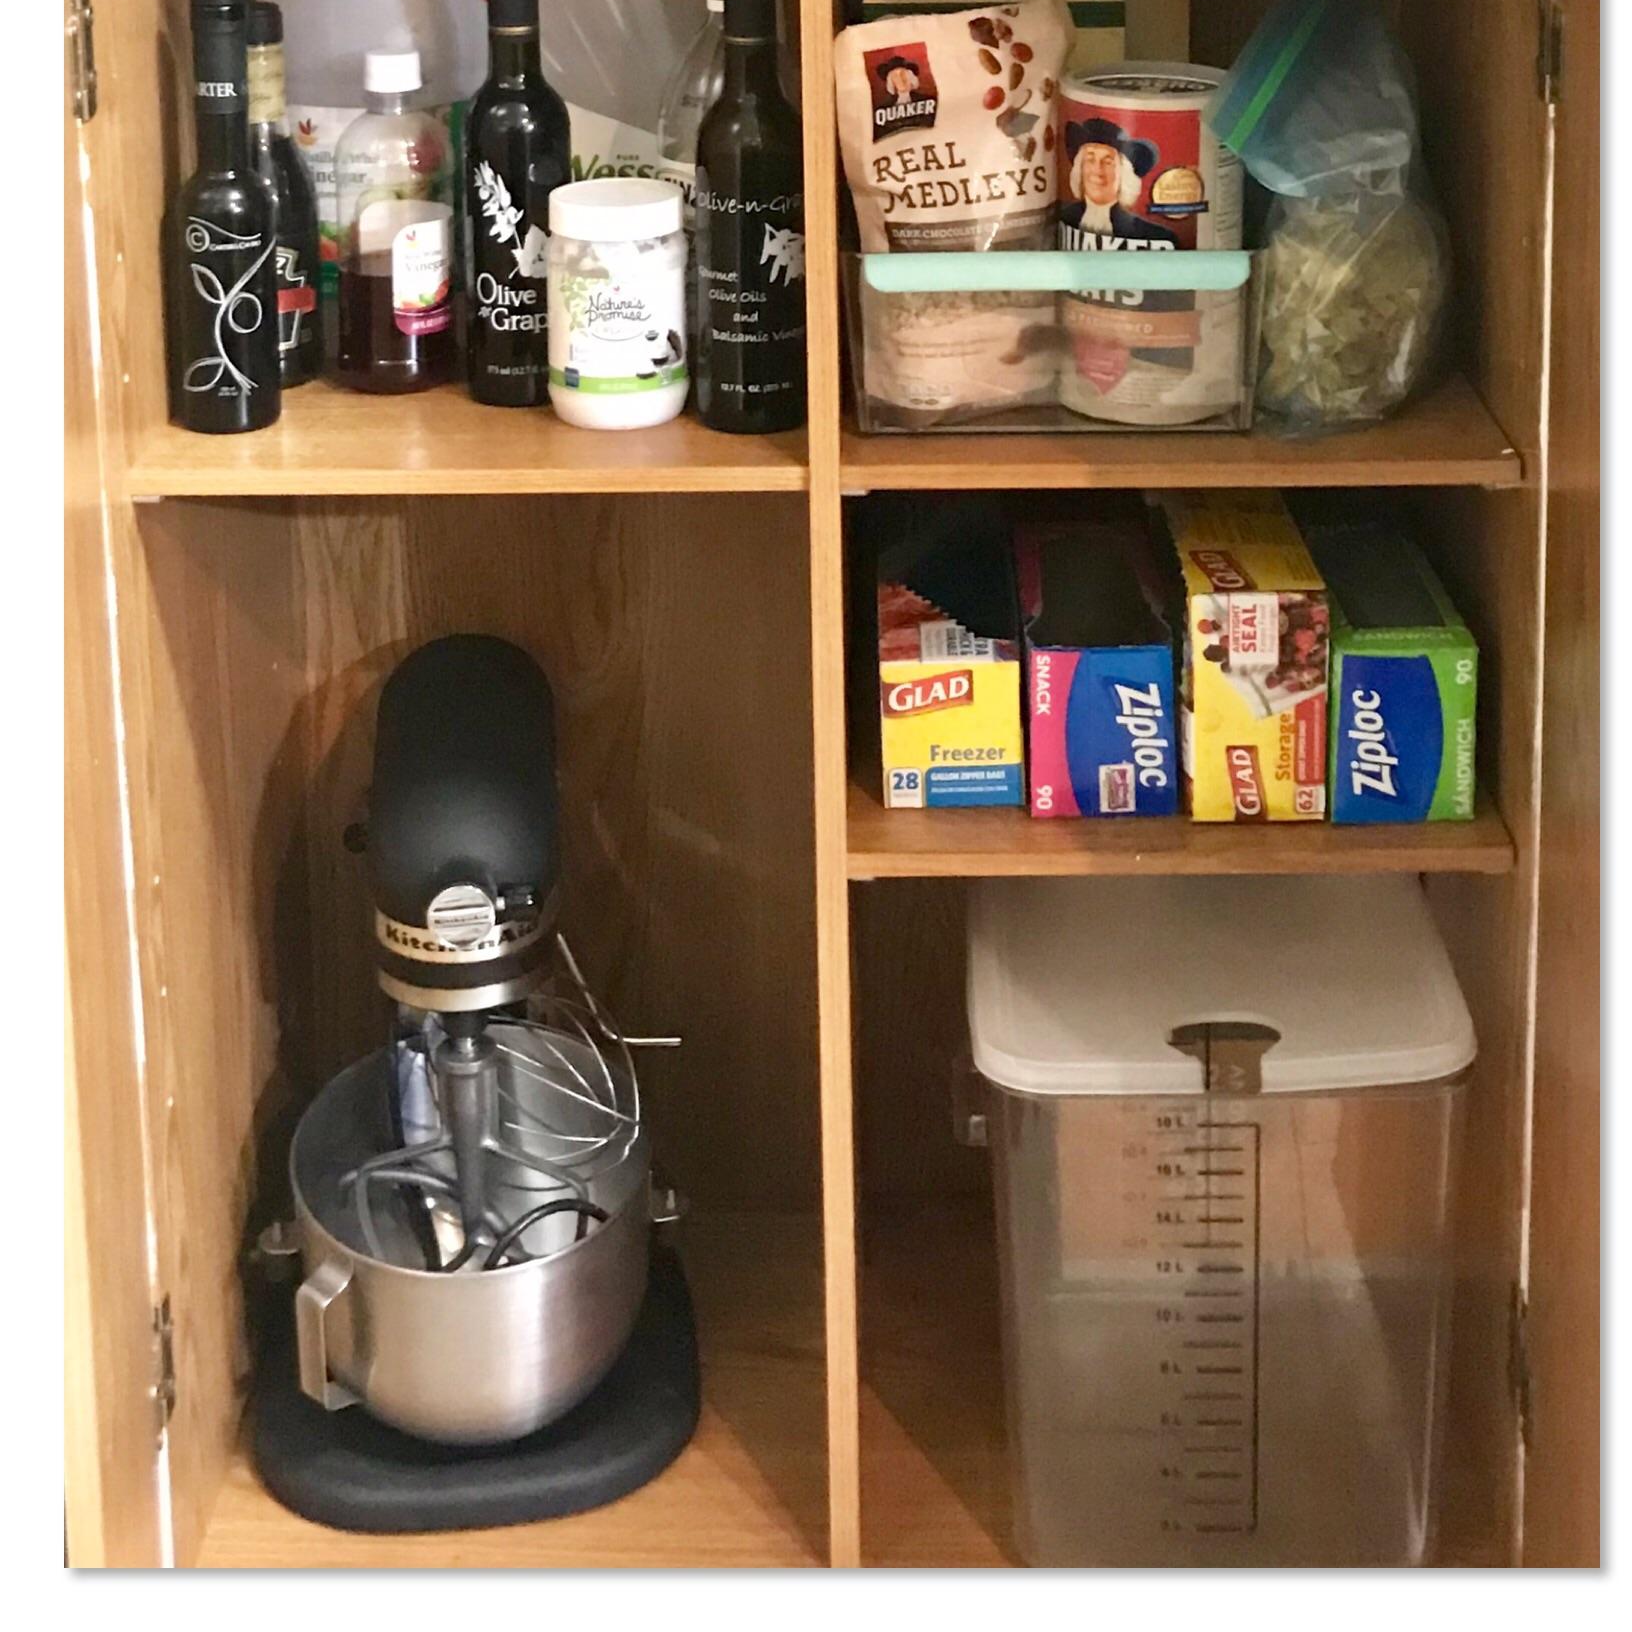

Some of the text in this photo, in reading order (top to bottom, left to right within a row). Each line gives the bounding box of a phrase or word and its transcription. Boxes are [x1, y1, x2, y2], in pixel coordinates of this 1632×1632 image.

[875, 99, 936, 126] QUAKER
[872, 141, 967, 184] REAL
[883, 165, 1048, 214] MEDLEYS
[476, 272, 538, 307] Olive
[586, 292, 646, 312] Nature's
[708, 288, 768, 303] Olive Oils
[490, 307, 550, 334] Grap
[584, 308, 652, 327] Promise
[732, 310, 760, 323] and
[711, 328, 769, 343] Balsamic
[1231, 604, 1242, 653] AIRTIGHT
[1241, 603, 1258, 653] SEAL
[887, 675, 970, 712] GLAD
[1036, 654, 1053, 810] SNACK 90
[1114, 682, 1169, 788] Ziploc
[1275, 711, 1298, 781] Storage
[1347, 688, 1399, 797] Ziploc
[1452, 659, 1474, 815] SANDWICH 90
[930, 744, 1006, 762] Freezer
[892, 772, 919, 790] 28
[1232, 749, 1261, 816] GLAD
[1299, 786, 1313, 811] 62
